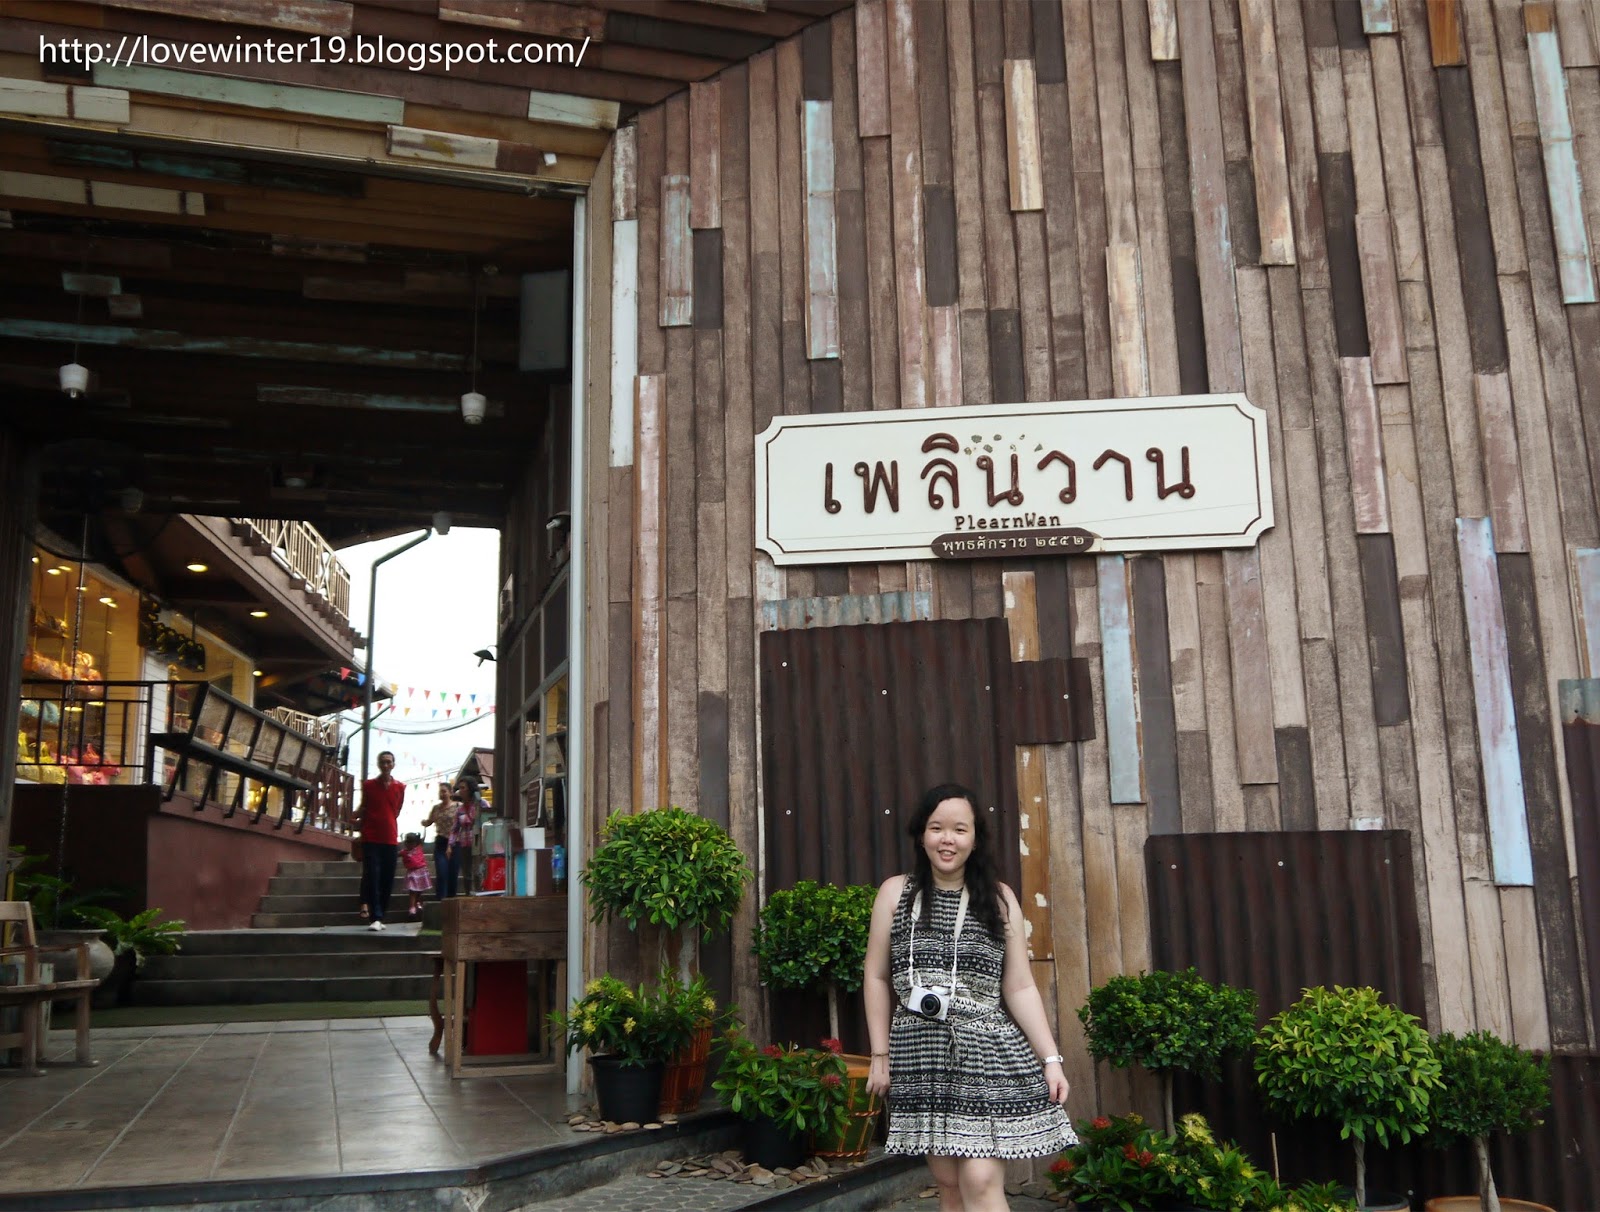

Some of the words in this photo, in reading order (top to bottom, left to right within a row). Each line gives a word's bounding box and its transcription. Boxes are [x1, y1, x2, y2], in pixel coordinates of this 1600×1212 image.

[824, 432, 1196, 514] เพลินวาน
[954, 512, 1061, 531] PlearnWan
[942, 535, 1027, 556] พุทธศักราช
